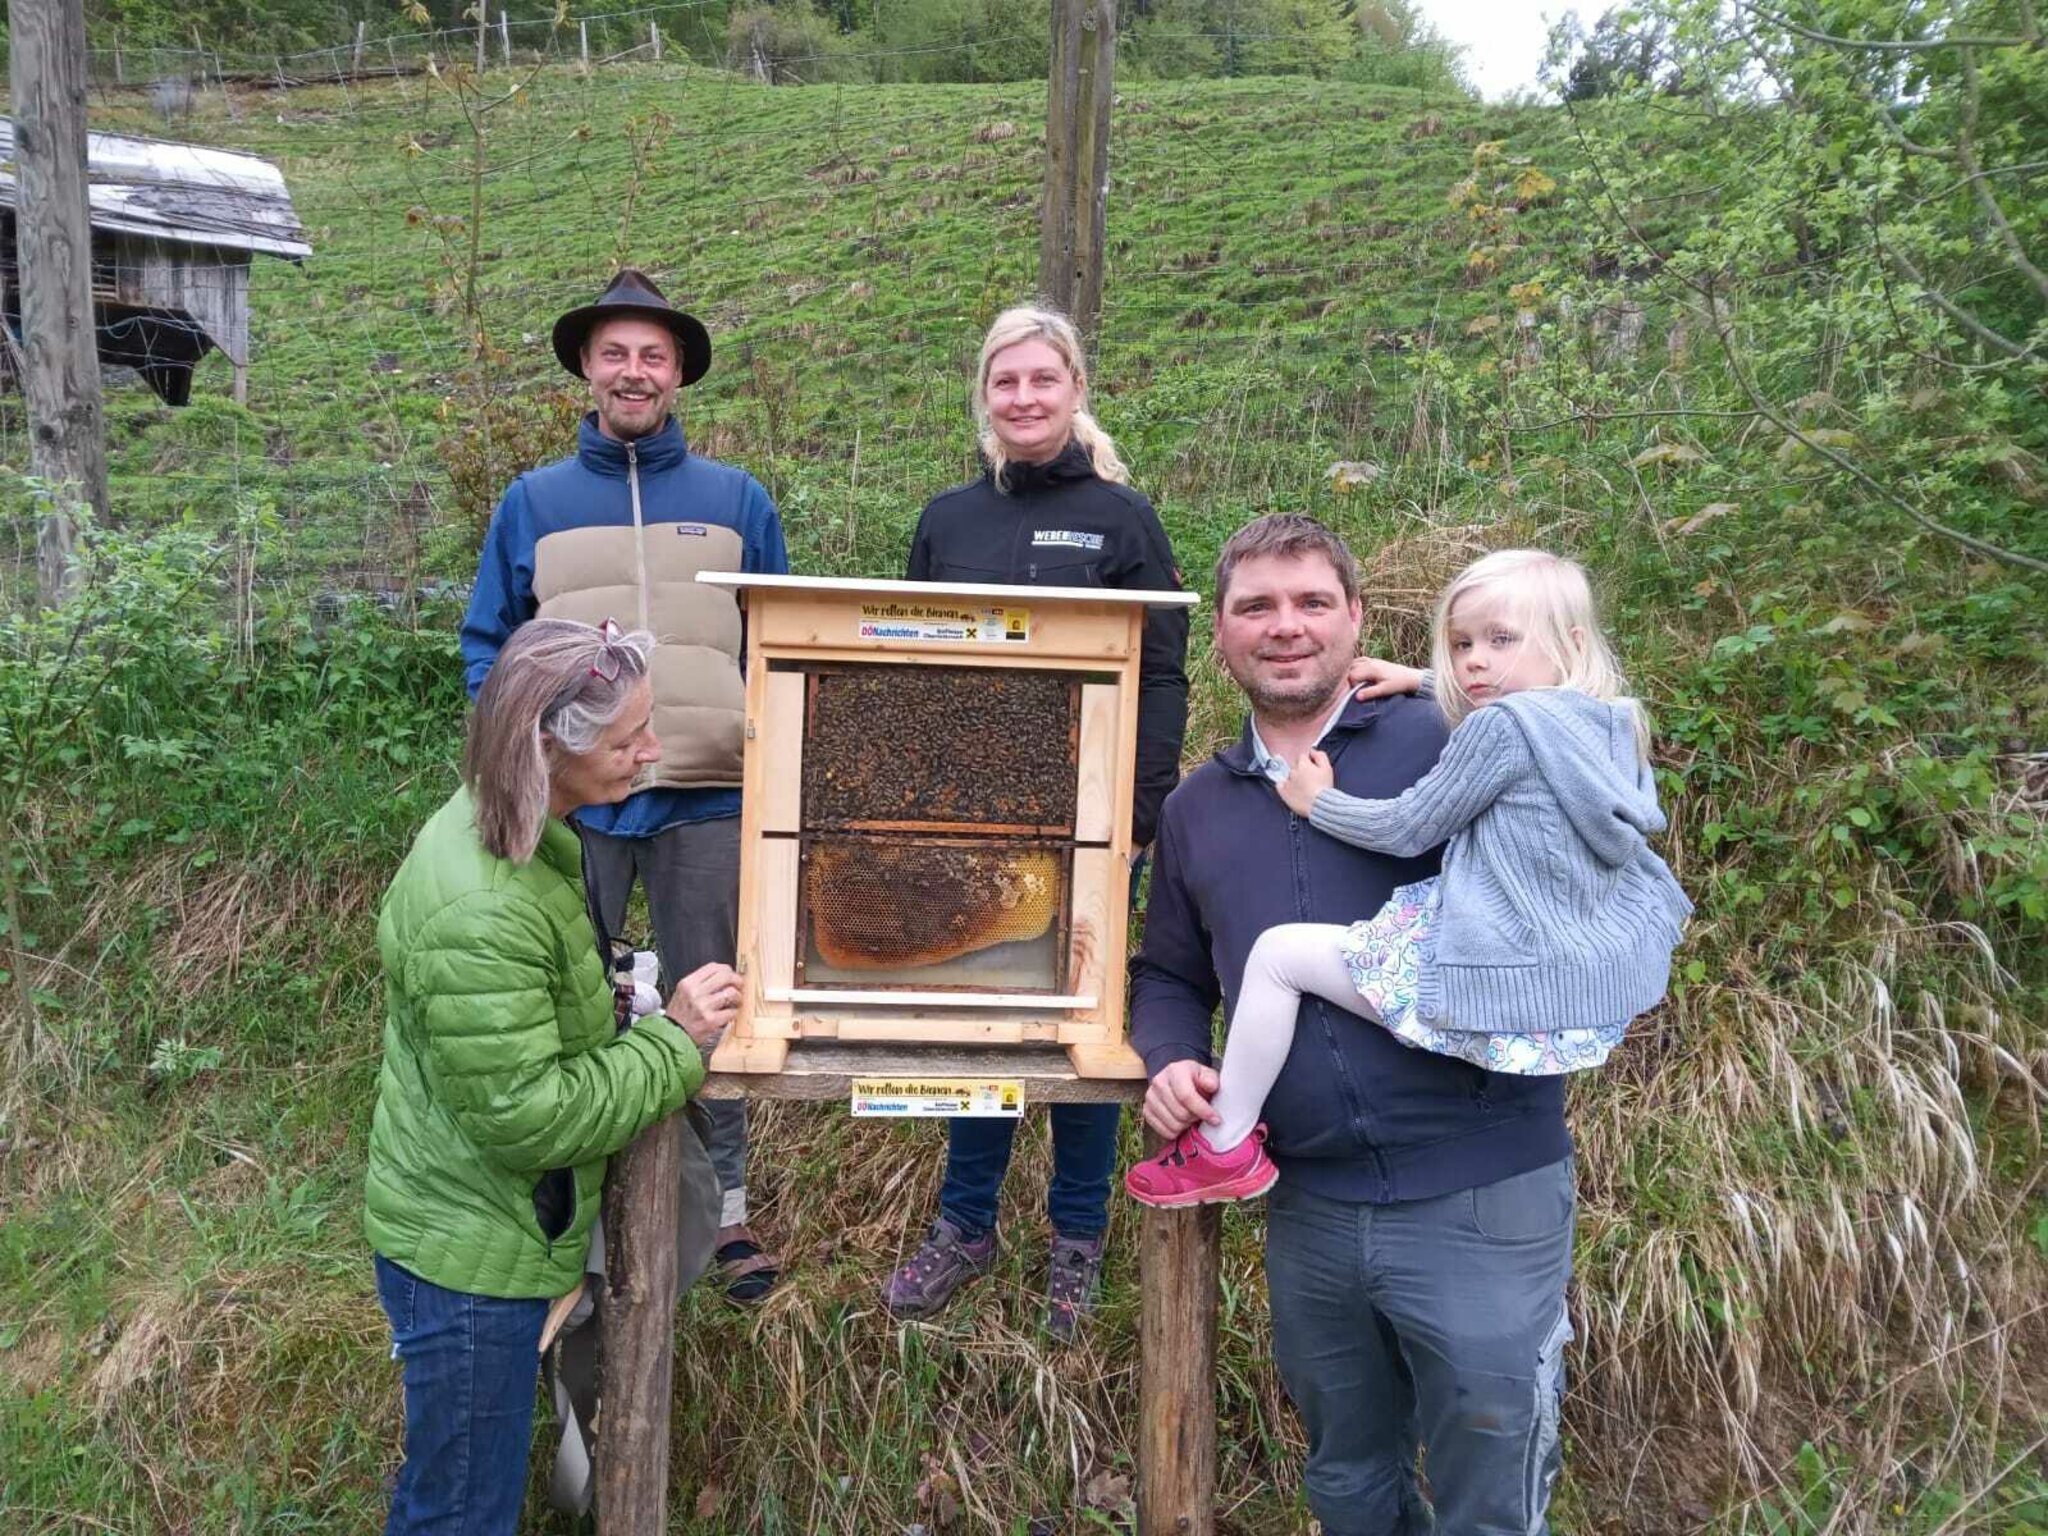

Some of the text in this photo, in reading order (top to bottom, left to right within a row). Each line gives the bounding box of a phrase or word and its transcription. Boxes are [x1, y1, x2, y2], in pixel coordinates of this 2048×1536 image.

[862, 603, 959, 619] Wir retten die Bienen
[858, 1084, 875, 1094] Wir
[905, 1083, 918, 1095] die
[920, 1084, 952, 1095] Bienen
